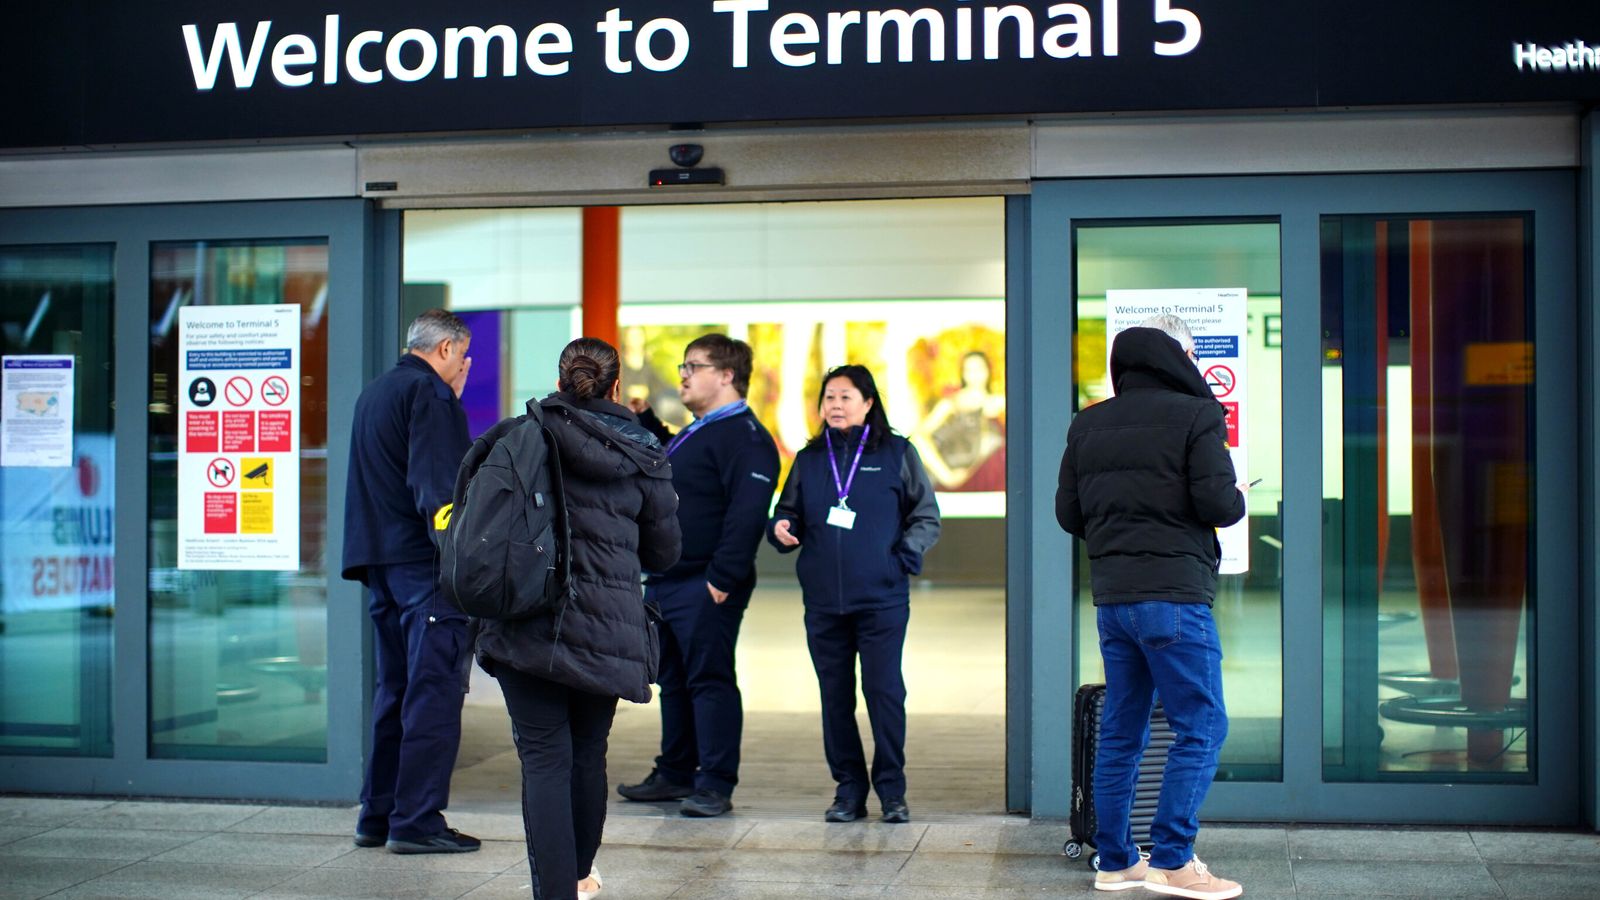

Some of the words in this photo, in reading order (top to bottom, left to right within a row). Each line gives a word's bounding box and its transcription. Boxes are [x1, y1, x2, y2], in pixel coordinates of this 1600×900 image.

[182, 15, 573, 89] Welcome
[597, 8, 690, 73] to
[713, 0, 1118, 68] Terminal
[1154, 0, 1202, 56] 5
[1115, 305, 1159, 314] Welcome
[1161, 305, 1172, 314] to
[1174, 304, 1215, 313] Terminal
[1217, 304, 1224, 313] 5
[186, 320, 224, 329] Welcome
[226, 320, 235, 329] to
[236, 319, 272, 328] Terminal
[274, 319, 280, 328] 5
[1202, 318, 1222, 326] please
